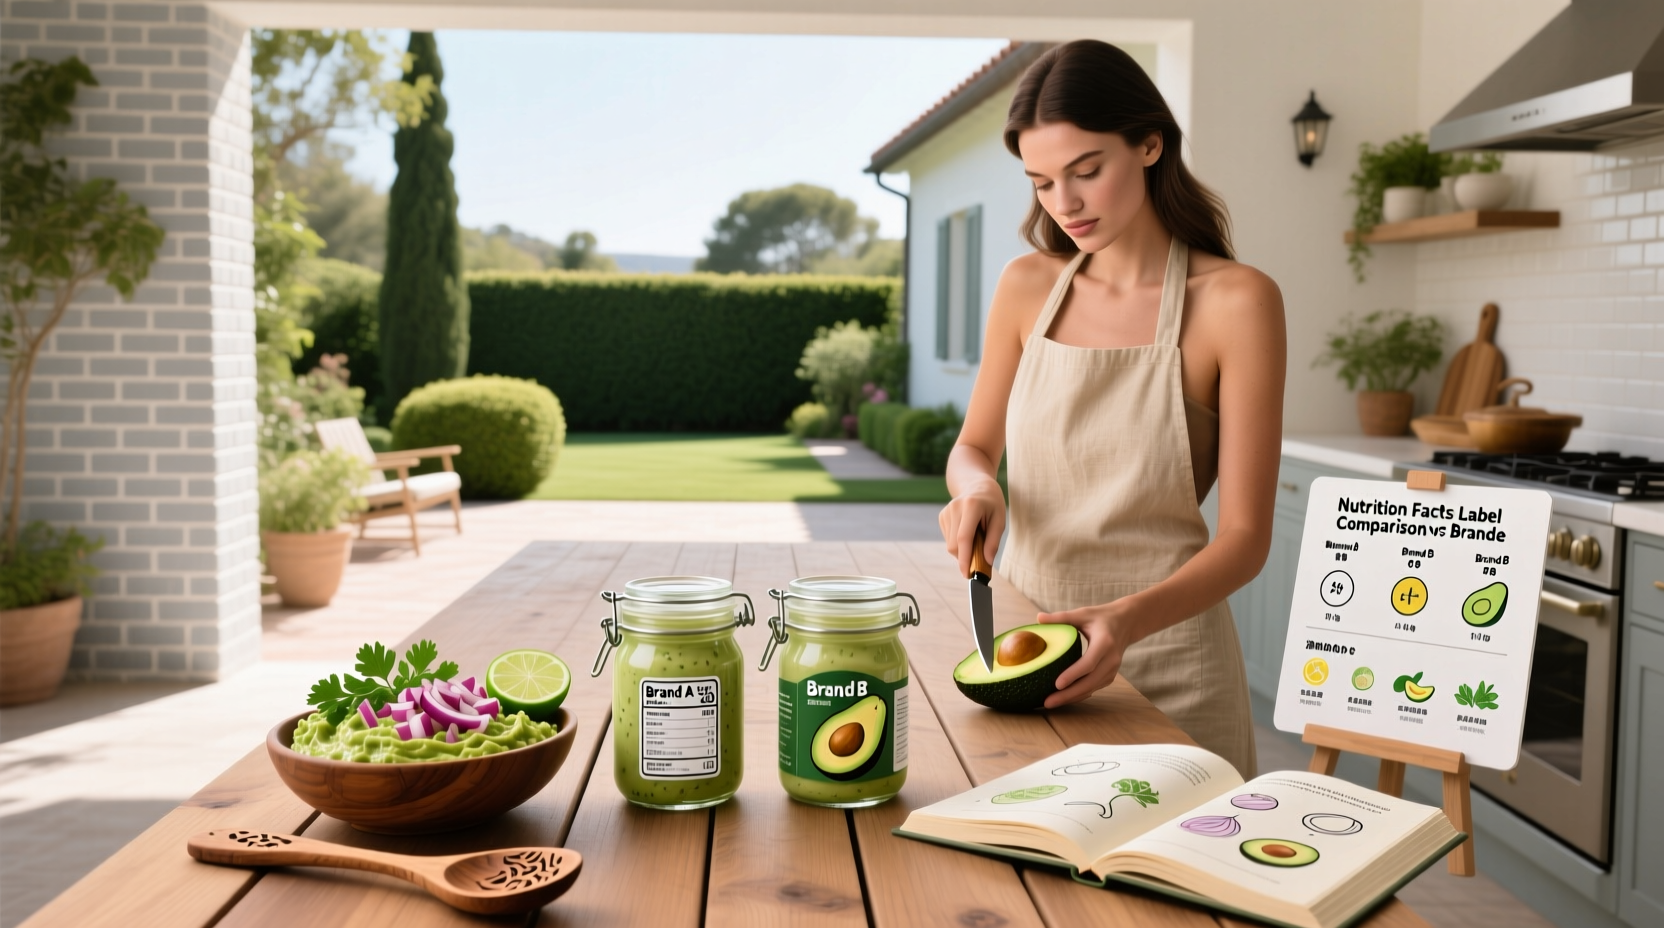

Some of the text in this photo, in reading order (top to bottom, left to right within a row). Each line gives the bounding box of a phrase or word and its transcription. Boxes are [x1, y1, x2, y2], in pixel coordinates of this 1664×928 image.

[1338, 497, 1503, 524] Nutrition Facts Label
[1336, 516, 1427, 536] Comparison
[1450, 523, 1506, 543] Brande
[646, 685, 682, 698] Brand
[685, 685, 694, 698] A
[807, 680, 868, 697] Brand B
